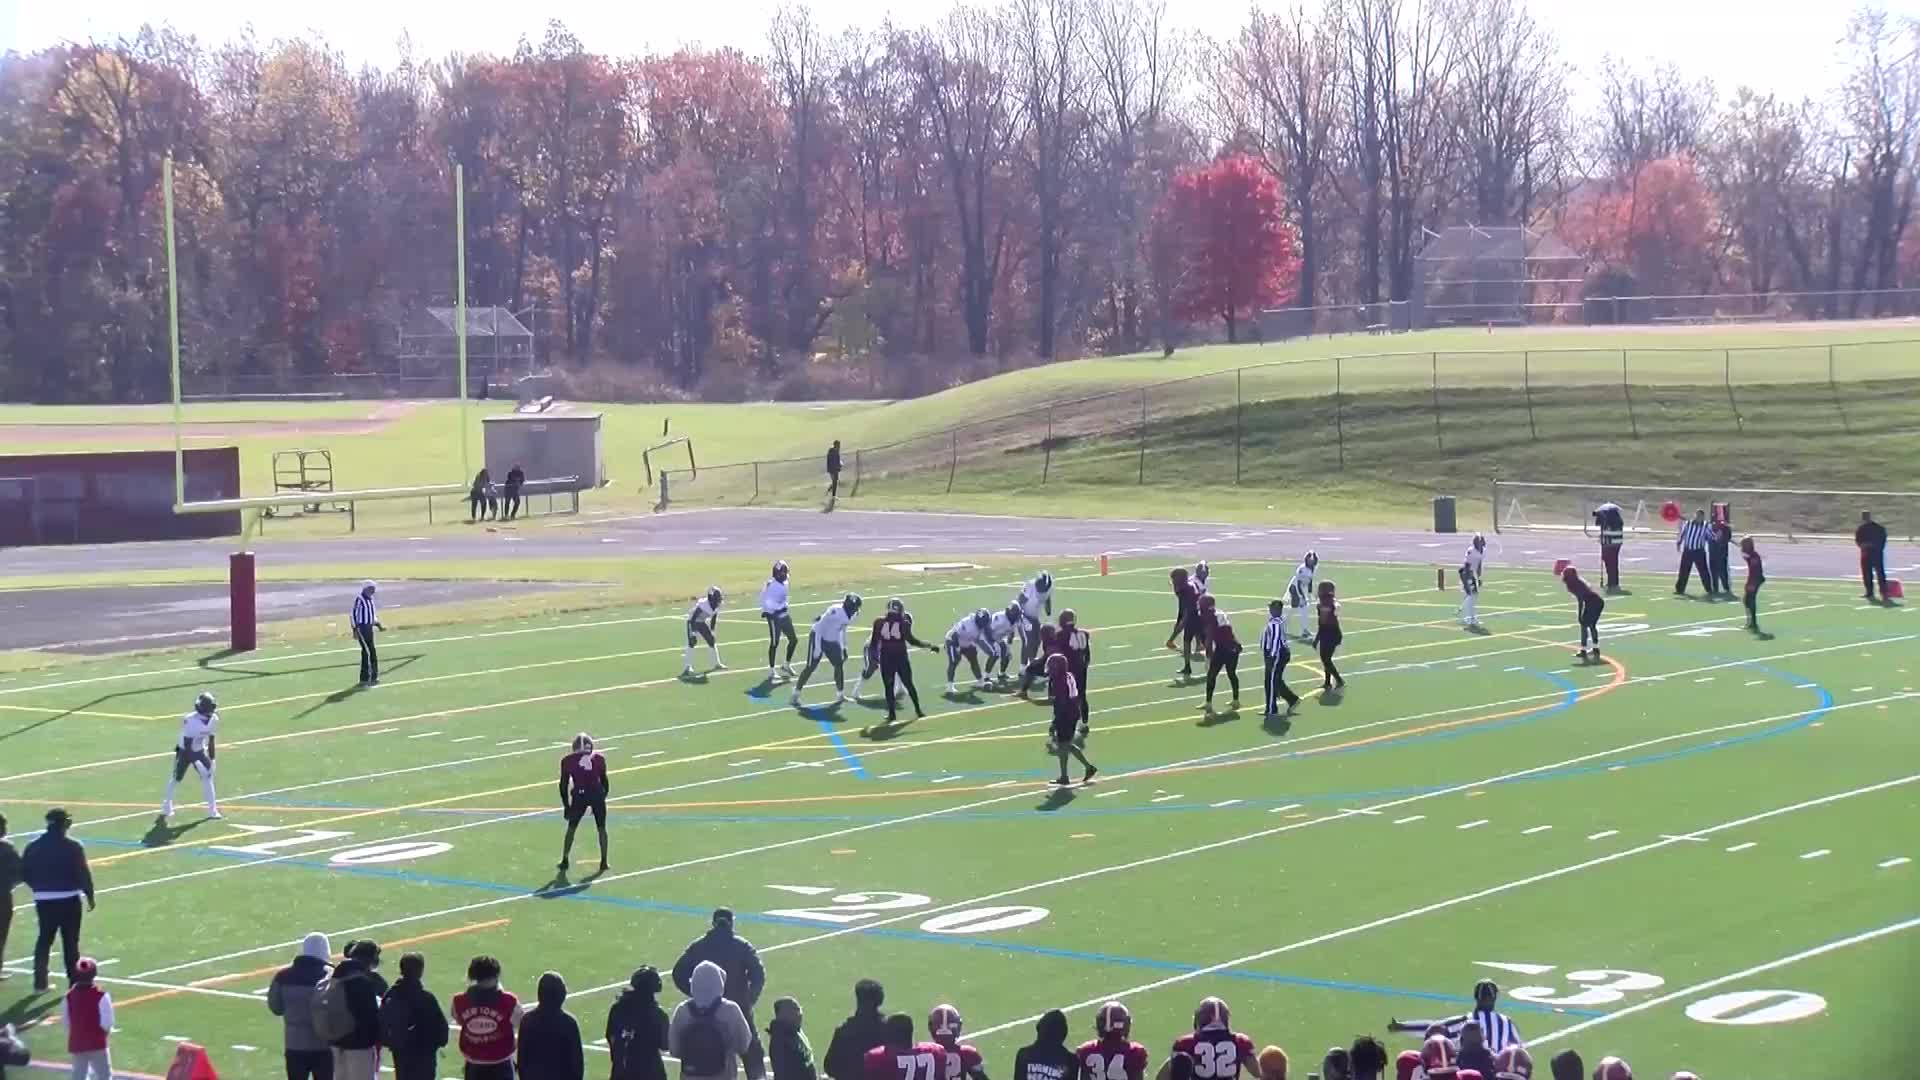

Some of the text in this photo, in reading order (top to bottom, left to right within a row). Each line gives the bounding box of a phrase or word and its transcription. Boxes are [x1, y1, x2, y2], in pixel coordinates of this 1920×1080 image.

[881, 622, 901, 640] 44
[897, 1052, 935, 1080] 77
[1086, 1053, 1128, 1080] 34
[1194, 1041, 1236, 1079] 32
